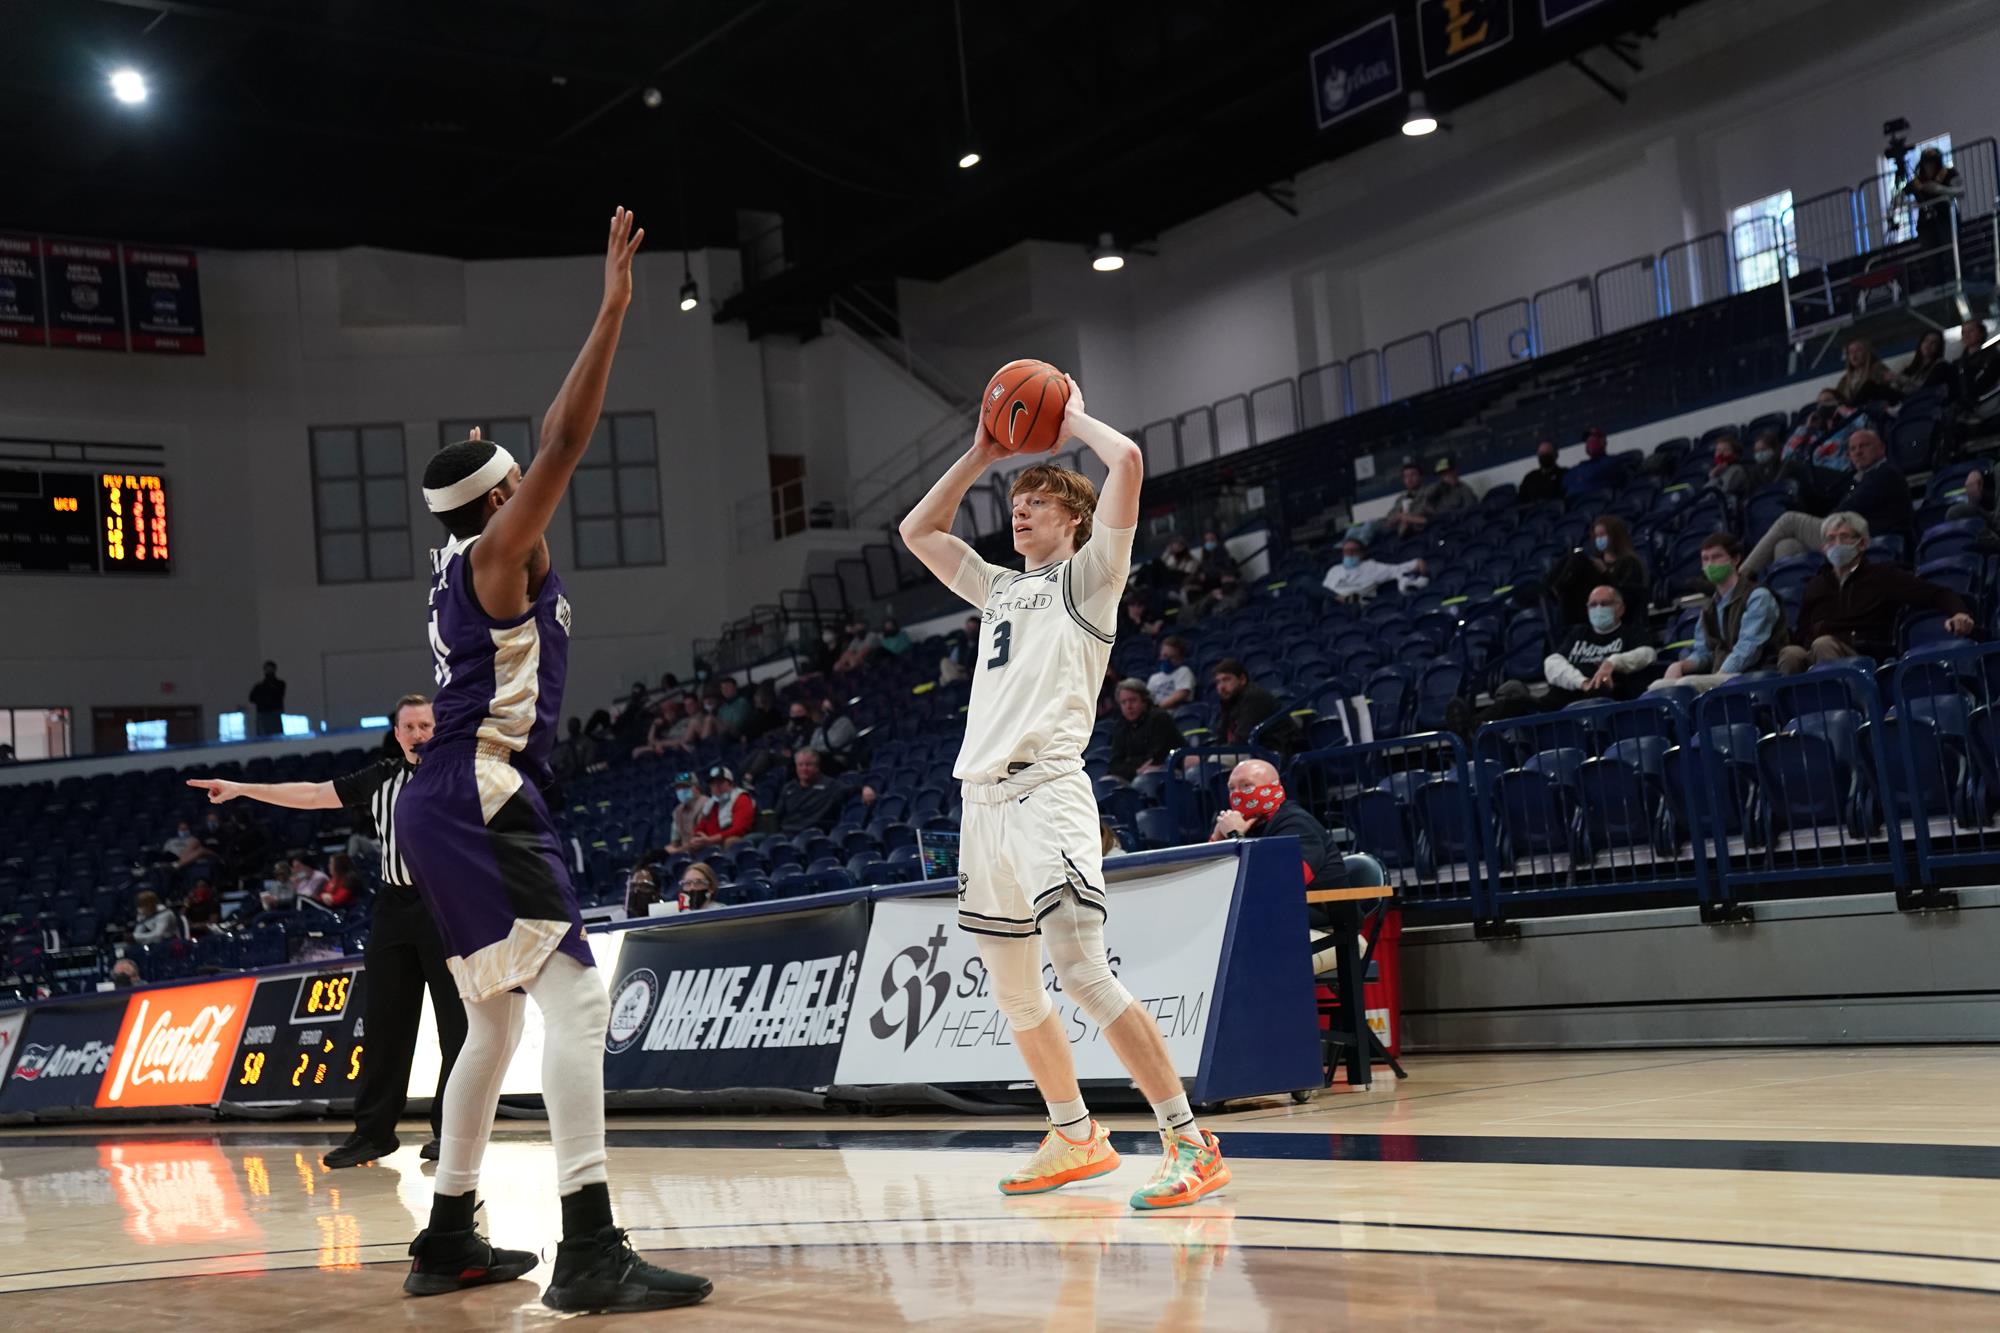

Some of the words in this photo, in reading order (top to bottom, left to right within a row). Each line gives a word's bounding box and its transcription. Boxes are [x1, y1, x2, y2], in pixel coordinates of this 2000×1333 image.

[986, 620, 1012, 671] 3
[307, 977, 349, 1013] 8:55
[655, 966, 752, 1019] MAKE
[740, 964, 774, 1014] A
[768, 955, 843, 1013] GIFT
[835, 950, 858, 1005] &
[641, 1016, 711, 1051] MAKE
[700, 1015, 731, 1050] A
[719, 1002, 850, 1050] DIFFERENCE
[1069, 991, 1204, 1044] STEM
[40, 1040, 115, 1078] AmFirs
[240, 1052, 265, 1084] 58
[292, 1053, 309, 1086] 2
